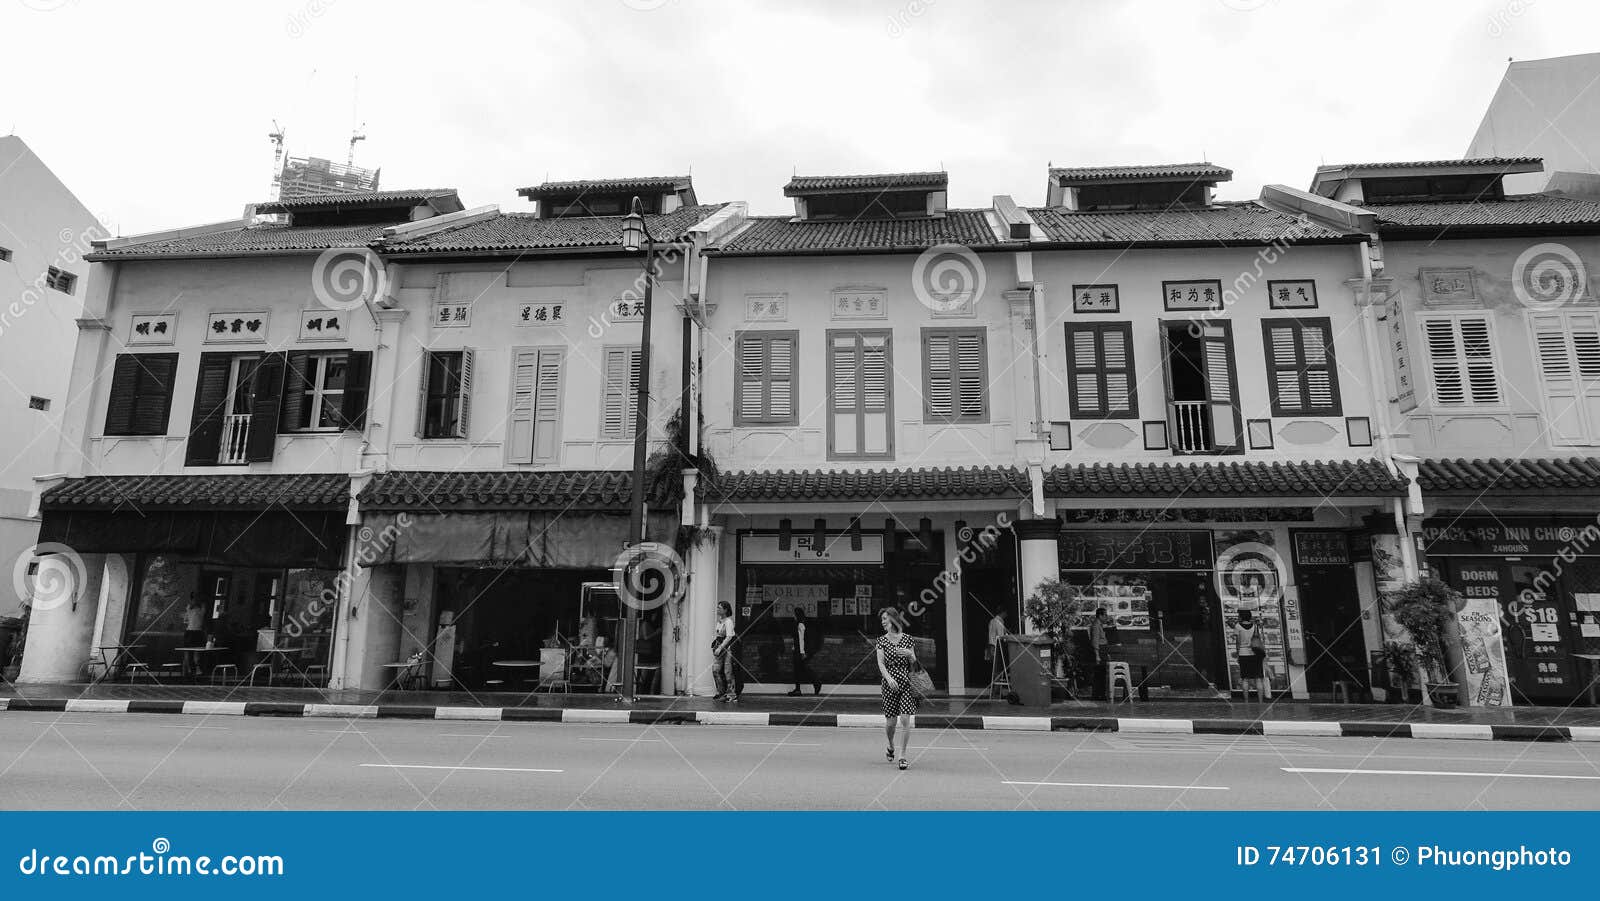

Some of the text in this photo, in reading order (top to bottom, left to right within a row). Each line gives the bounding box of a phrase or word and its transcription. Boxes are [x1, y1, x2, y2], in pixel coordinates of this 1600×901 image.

[1170, 288, 1215, 302] 和为贵
[1505, 527, 1530, 541] INN
[1493, 544, 1529, 553] 24HOURS
[1461, 570, 1499, 581] DORM
[764, 586, 828, 597] KOREAN
[1466, 585, 1499, 597] BEDS
[1525, 607, 1559, 623] $18
